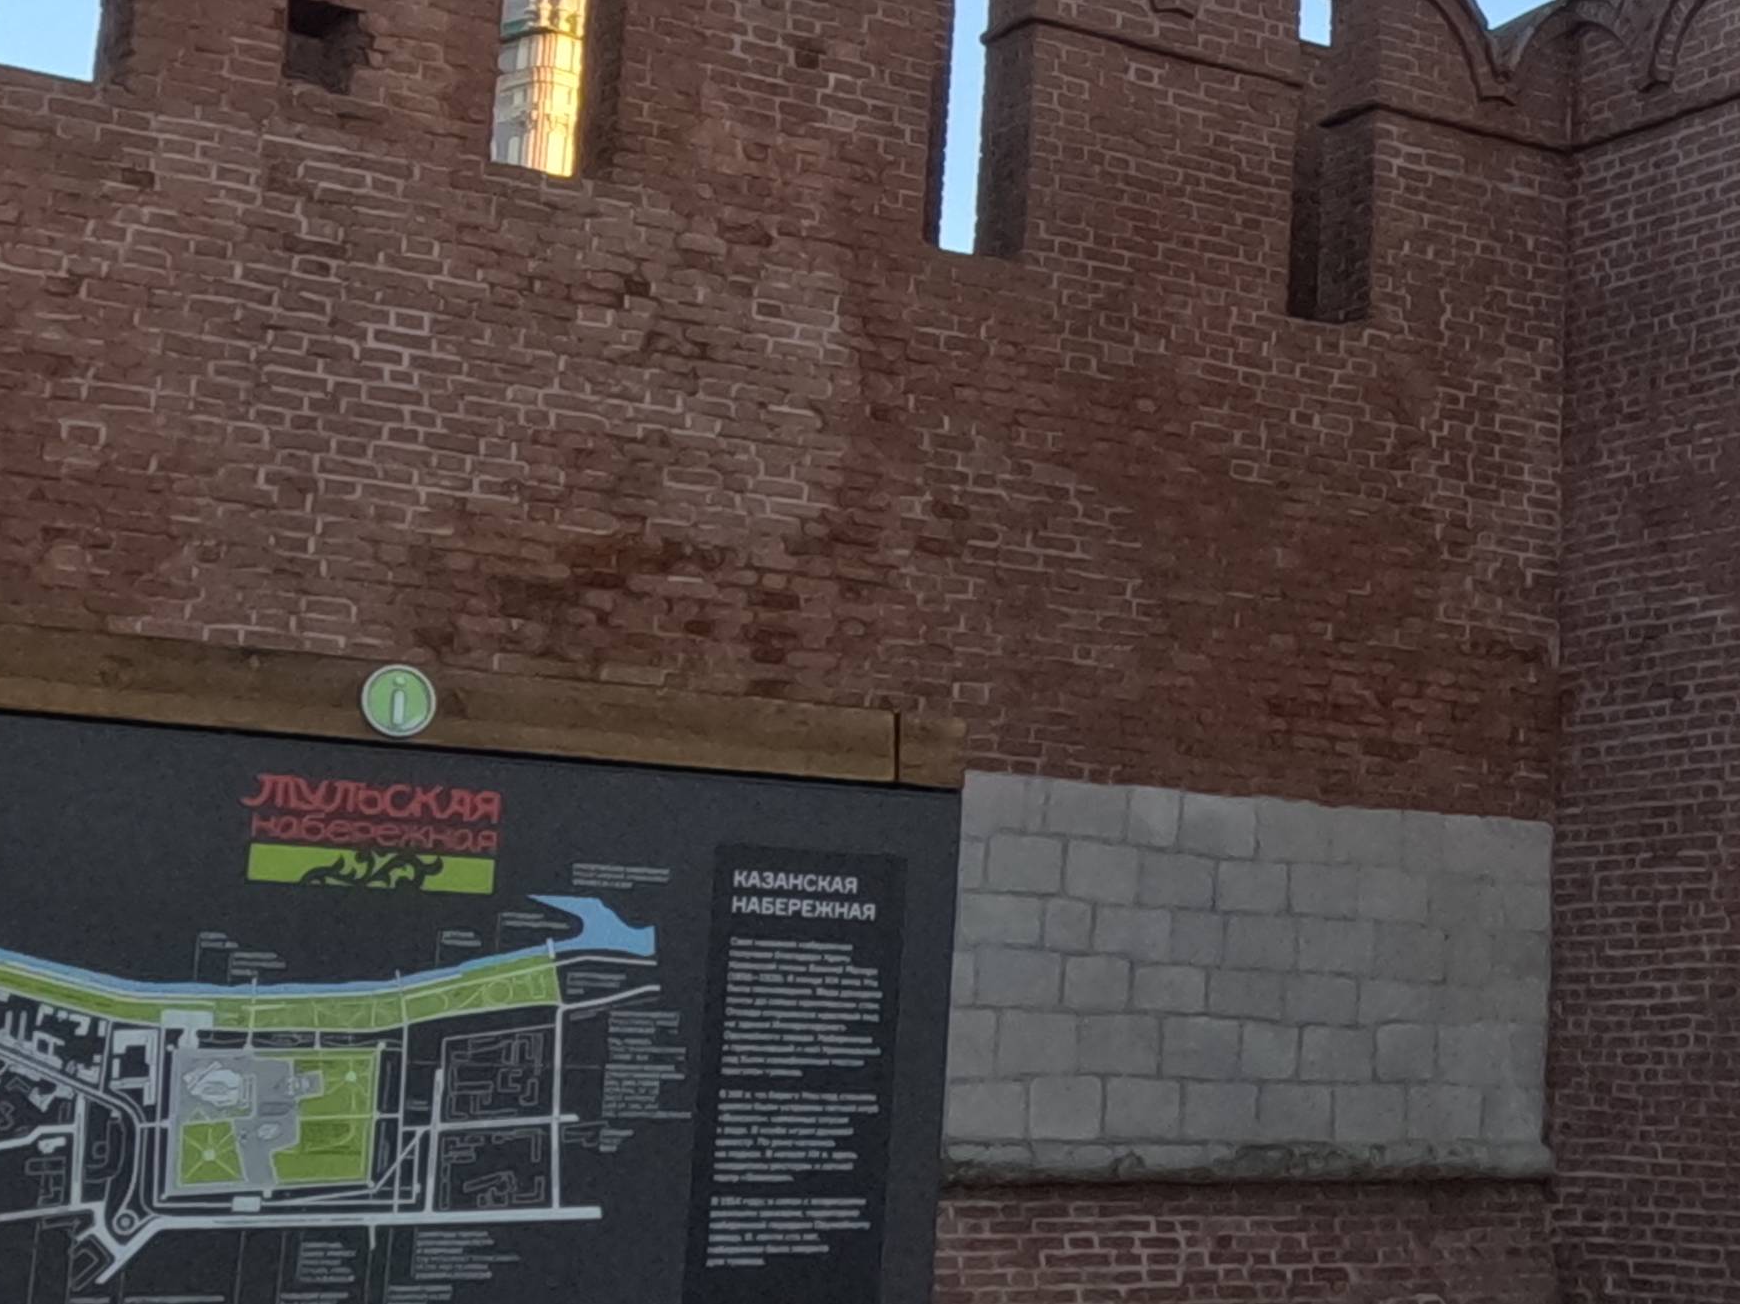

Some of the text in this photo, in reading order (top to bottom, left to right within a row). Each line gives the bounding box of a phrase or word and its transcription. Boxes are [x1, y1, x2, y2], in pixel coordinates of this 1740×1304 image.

[251, 812, 499, 853] набережная
[733, 869, 858, 894] КАЗАНСКАЯ
[731, 894, 876, 921] НАБЕРЕЖНАЯ
